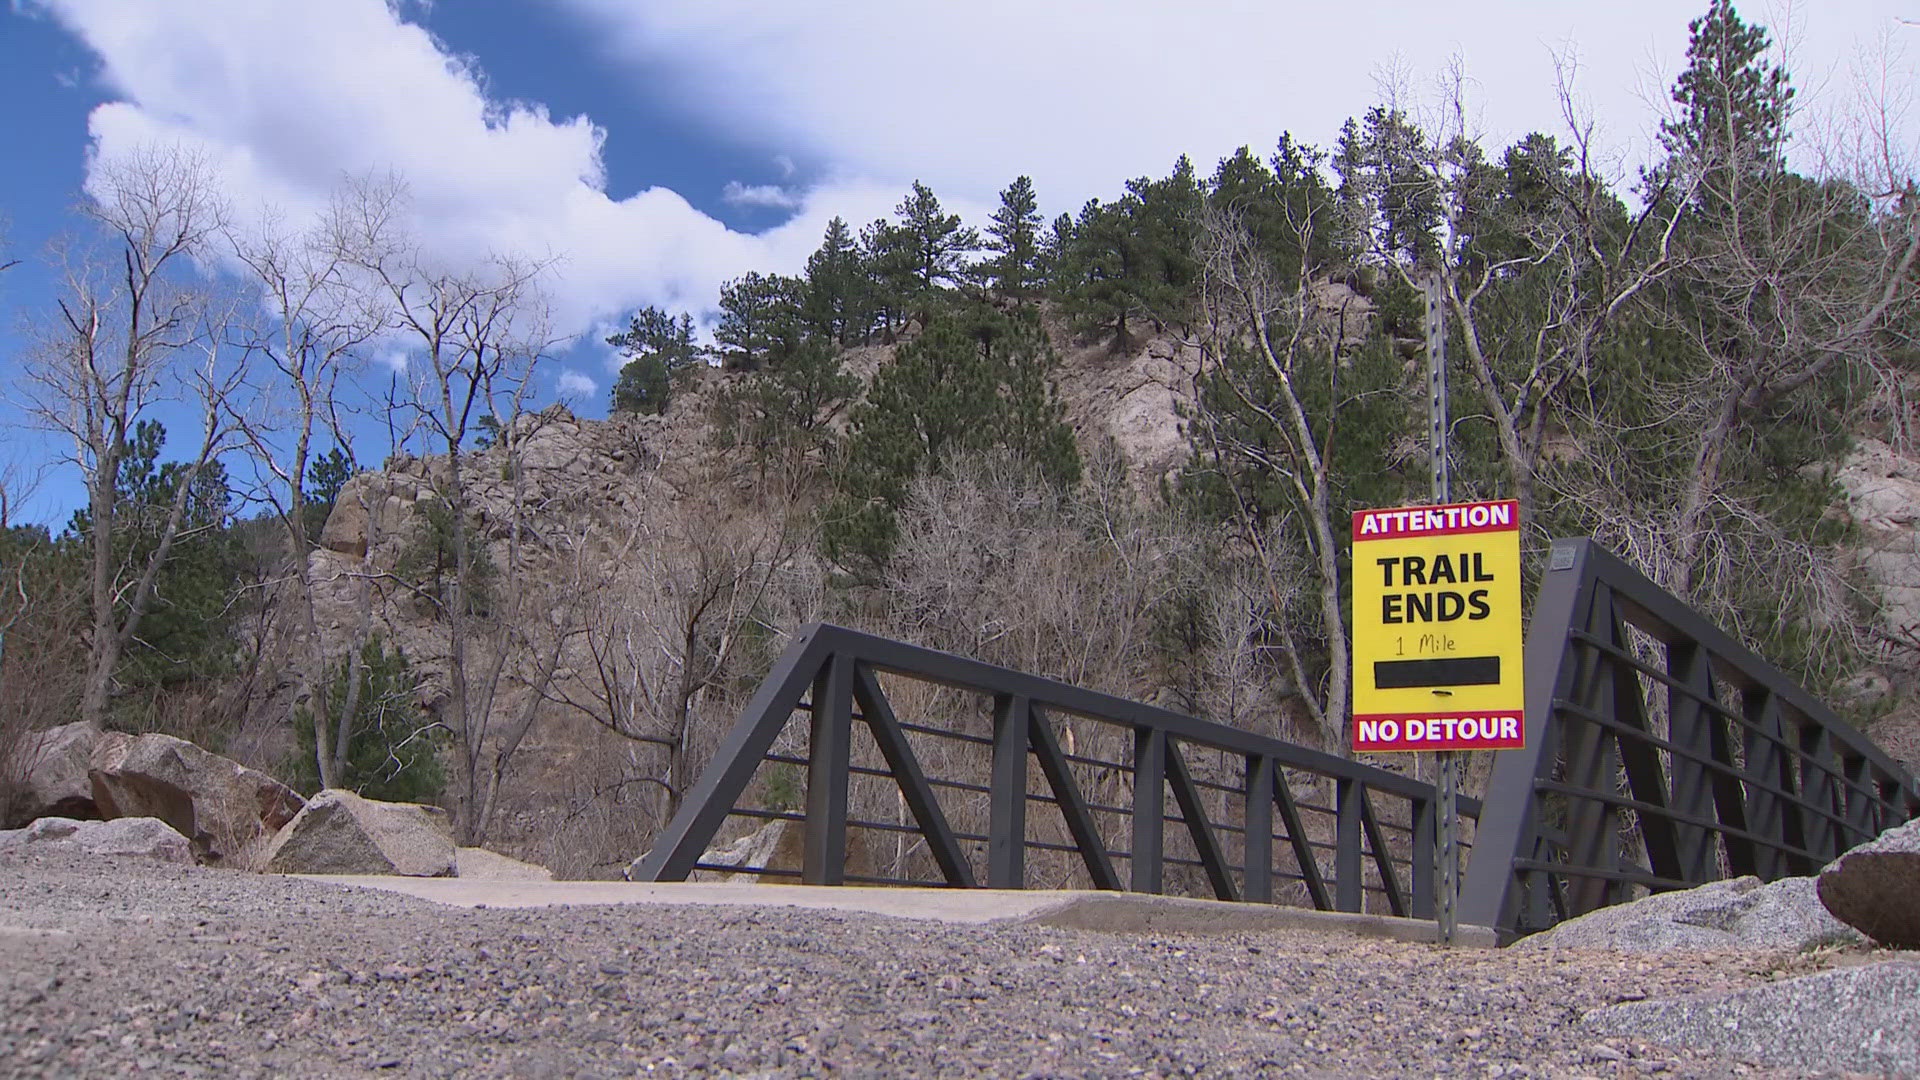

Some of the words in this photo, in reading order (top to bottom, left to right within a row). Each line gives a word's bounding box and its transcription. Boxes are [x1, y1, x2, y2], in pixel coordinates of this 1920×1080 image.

[1360, 504, 1509, 534] ATTENTION
[1377, 552, 1494, 587] TRAIL
[1382, 589, 1490, 624] ENDS
[1395, 636, 1404, 656] 1
[1419, 634, 1456, 654] Mile
[1358, 720, 1399, 742] NO
[1405, 717, 1518, 741] DETOUR
